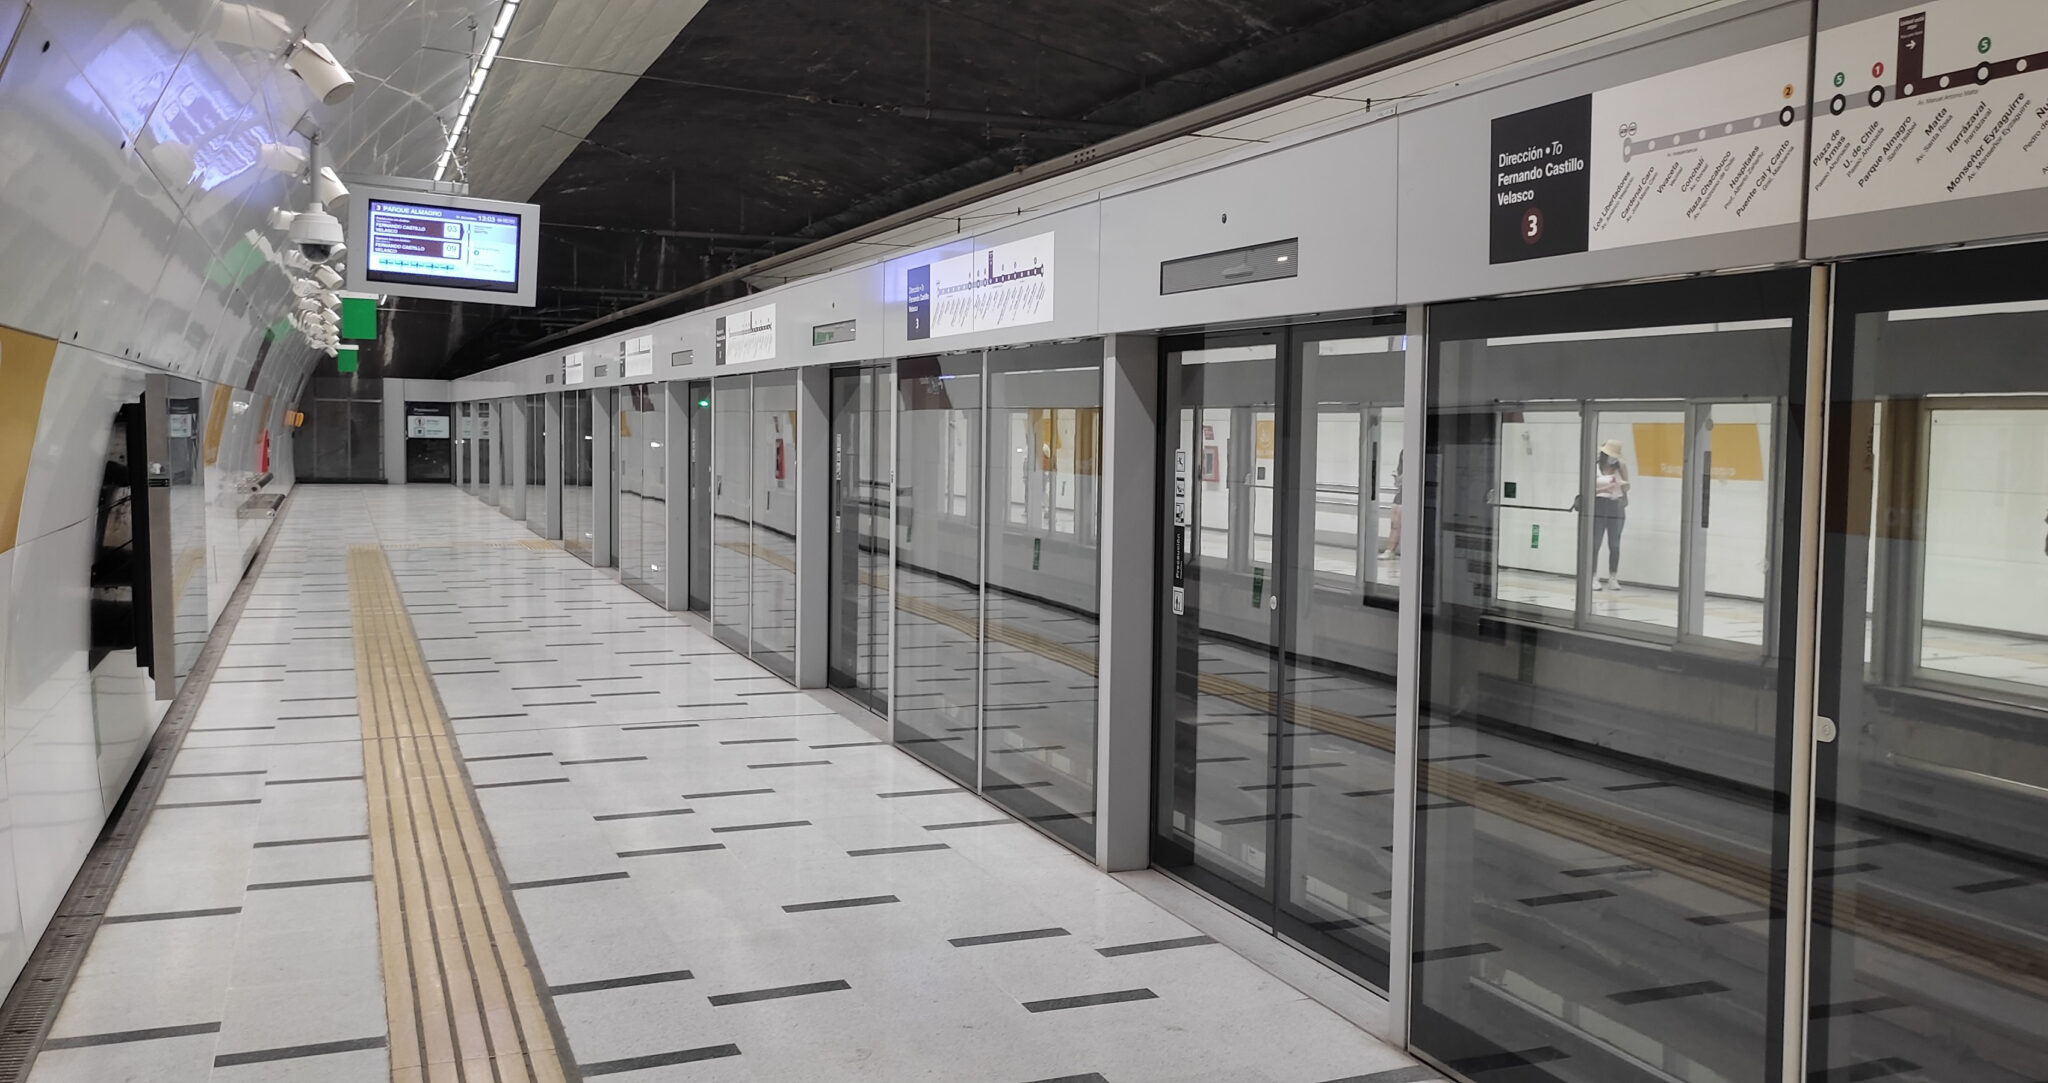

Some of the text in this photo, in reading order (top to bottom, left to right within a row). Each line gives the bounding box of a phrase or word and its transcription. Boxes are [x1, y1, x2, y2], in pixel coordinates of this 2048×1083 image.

[1980, 39, 1989, 51] 5
[1924, 107, 1948, 137] Matta
[1946, 100, 1987, 153] Irarrázaval
[2022, 130, 2041, 152] Pedro
[1499, 140, 1563, 168] Dirección To
[1812, 129, 1841, 167] Plaza de
[1824, 135, 1846, 166] Armas
[1843, 120, 1879, 169] U. de Chile
[1858, 115, 1912, 188] Parque Almagro
[1946, 92, 2025, 193] Monseñor Eyzaguirre
[1498, 157, 1584, 187] Fernando Castillo
[1656, 161, 1680, 194] Vivaceta
[1680, 155, 1705, 193] Conchalí
[1686, 150, 1732, 218] Plaza Chacabuco
[1728, 145, 1760, 190] Hospitales
[1735, 139, 1790, 217] Puente Cal y Canto
[1497, 189, 1534, 206] Velasco
[1593, 171, 1631, 231] Los Libertadores
[1620, 166, 1655, 219] Cardenal Caro
[447, 225, 457, 233] 03
[1527, 214, 1538, 237] 3
